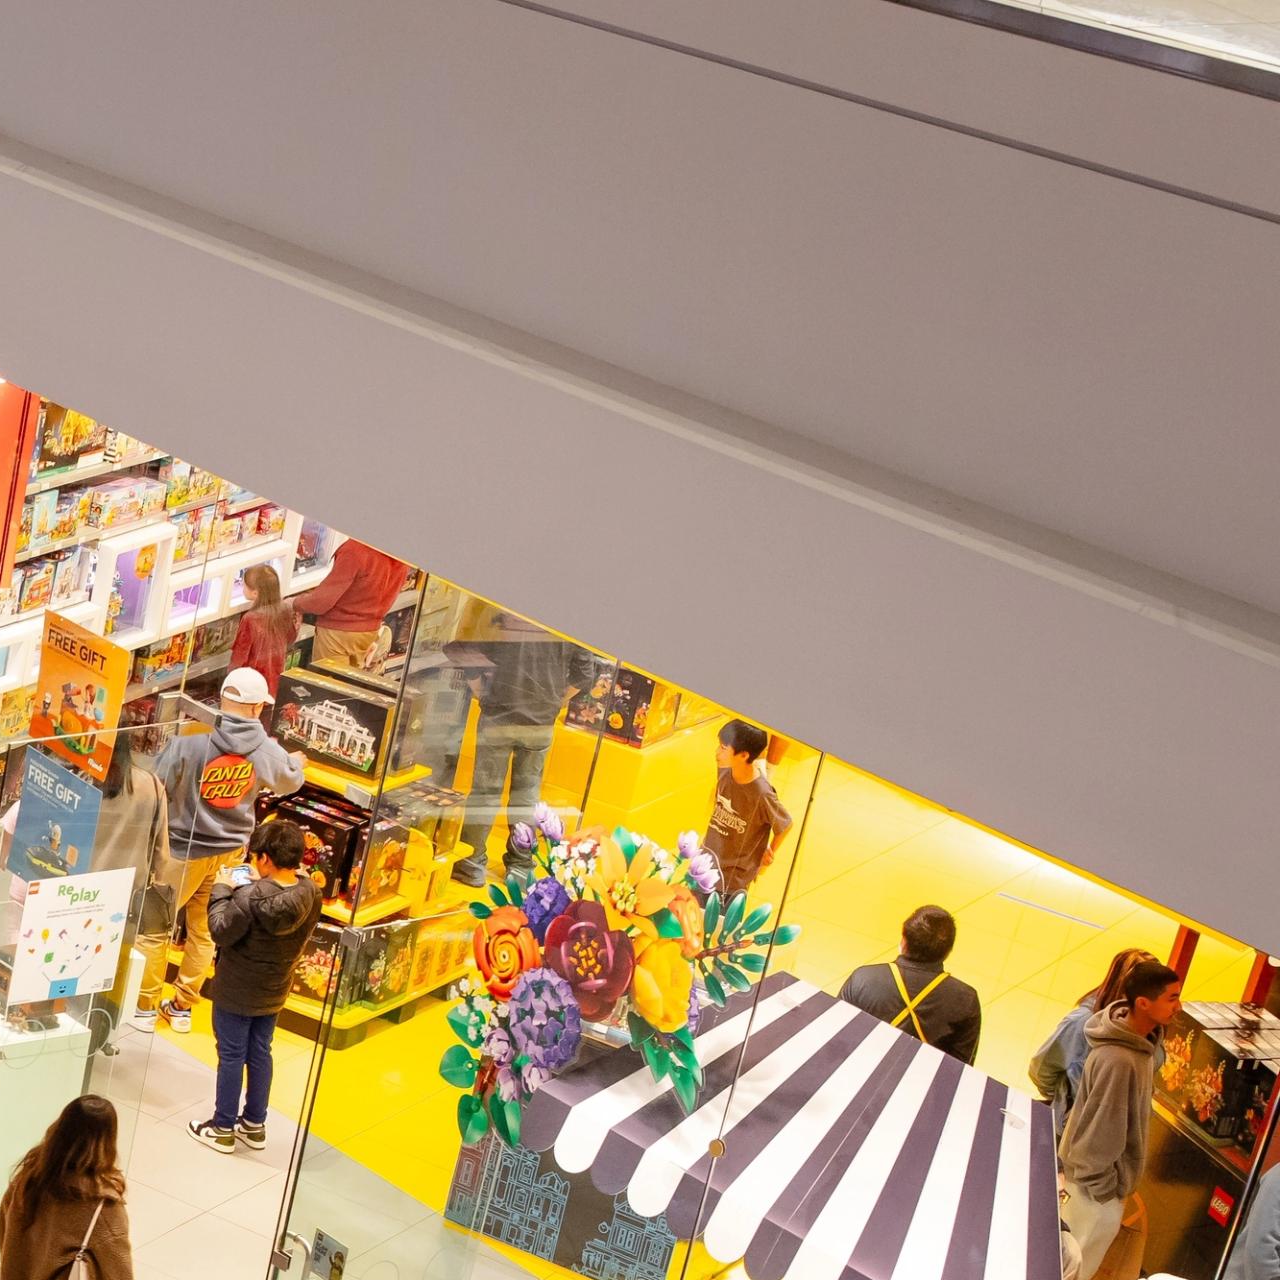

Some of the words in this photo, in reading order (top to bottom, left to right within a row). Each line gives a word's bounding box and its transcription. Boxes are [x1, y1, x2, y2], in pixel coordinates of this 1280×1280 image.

[47, 628, 78, 656] FREE
[79, 645, 107, 671] GIFT
[198, 762, 253, 783] SANTA
[28, 764, 55, 794] FREE
[55, 783, 82, 811] GIFT
[202, 780, 249, 799] CRUZ
[1211, 1197, 1230, 1216] LEGO
